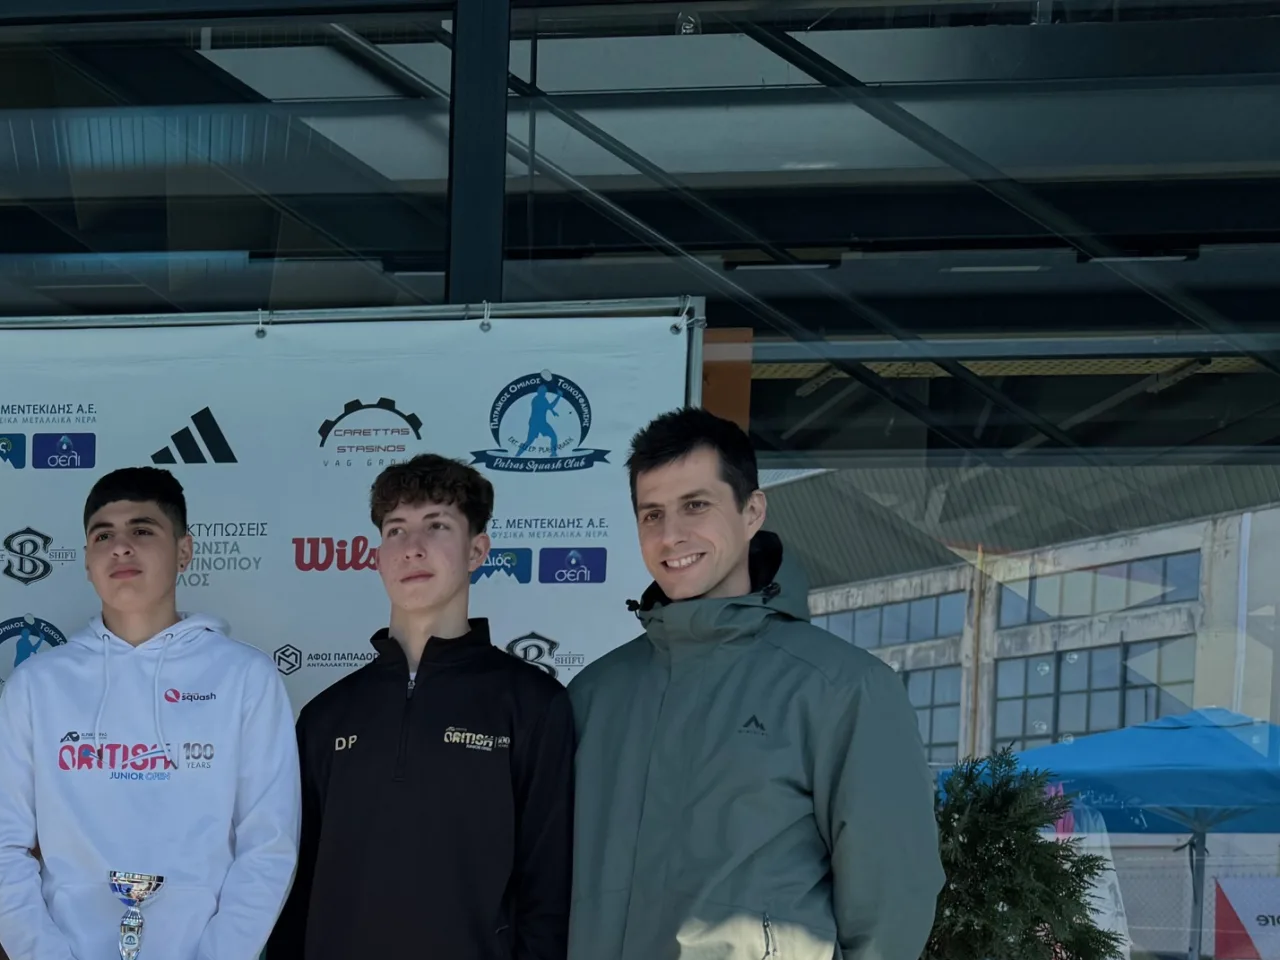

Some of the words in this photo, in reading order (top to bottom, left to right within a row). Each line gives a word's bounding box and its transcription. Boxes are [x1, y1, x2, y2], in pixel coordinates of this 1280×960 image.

[0, 404, 73, 415] ΜΕΝΤΕΚΙΔΗΣ
[334, 428, 410, 437] CARETTAS
[337, 445, 406, 453] STASINOS
[525, 460, 561, 473] Squash
[564, 457, 586, 468] Club
[506, 518, 583, 528] ΜΕΝΤΕΚΙΔΗΣ
[186, 522, 268, 537] ΚΤΥΠΩΣΕΙΣ
[192, 541, 241, 555] ΩΝΣΤΑ
[48, 551, 77, 559] SHIFU
[292, 535, 380, 572] Wils
[189, 557, 262, 571] ΤΙΝΟΠΟΥ
[307, 653, 331, 661] ΑΦΟΙ
[555, 656, 585, 665] SHIFU
[181, 692, 217, 702] squash
[335, 735, 358, 751] DP
[183, 743, 215, 760] 100
[109, 772, 144, 781] JUNIOR
